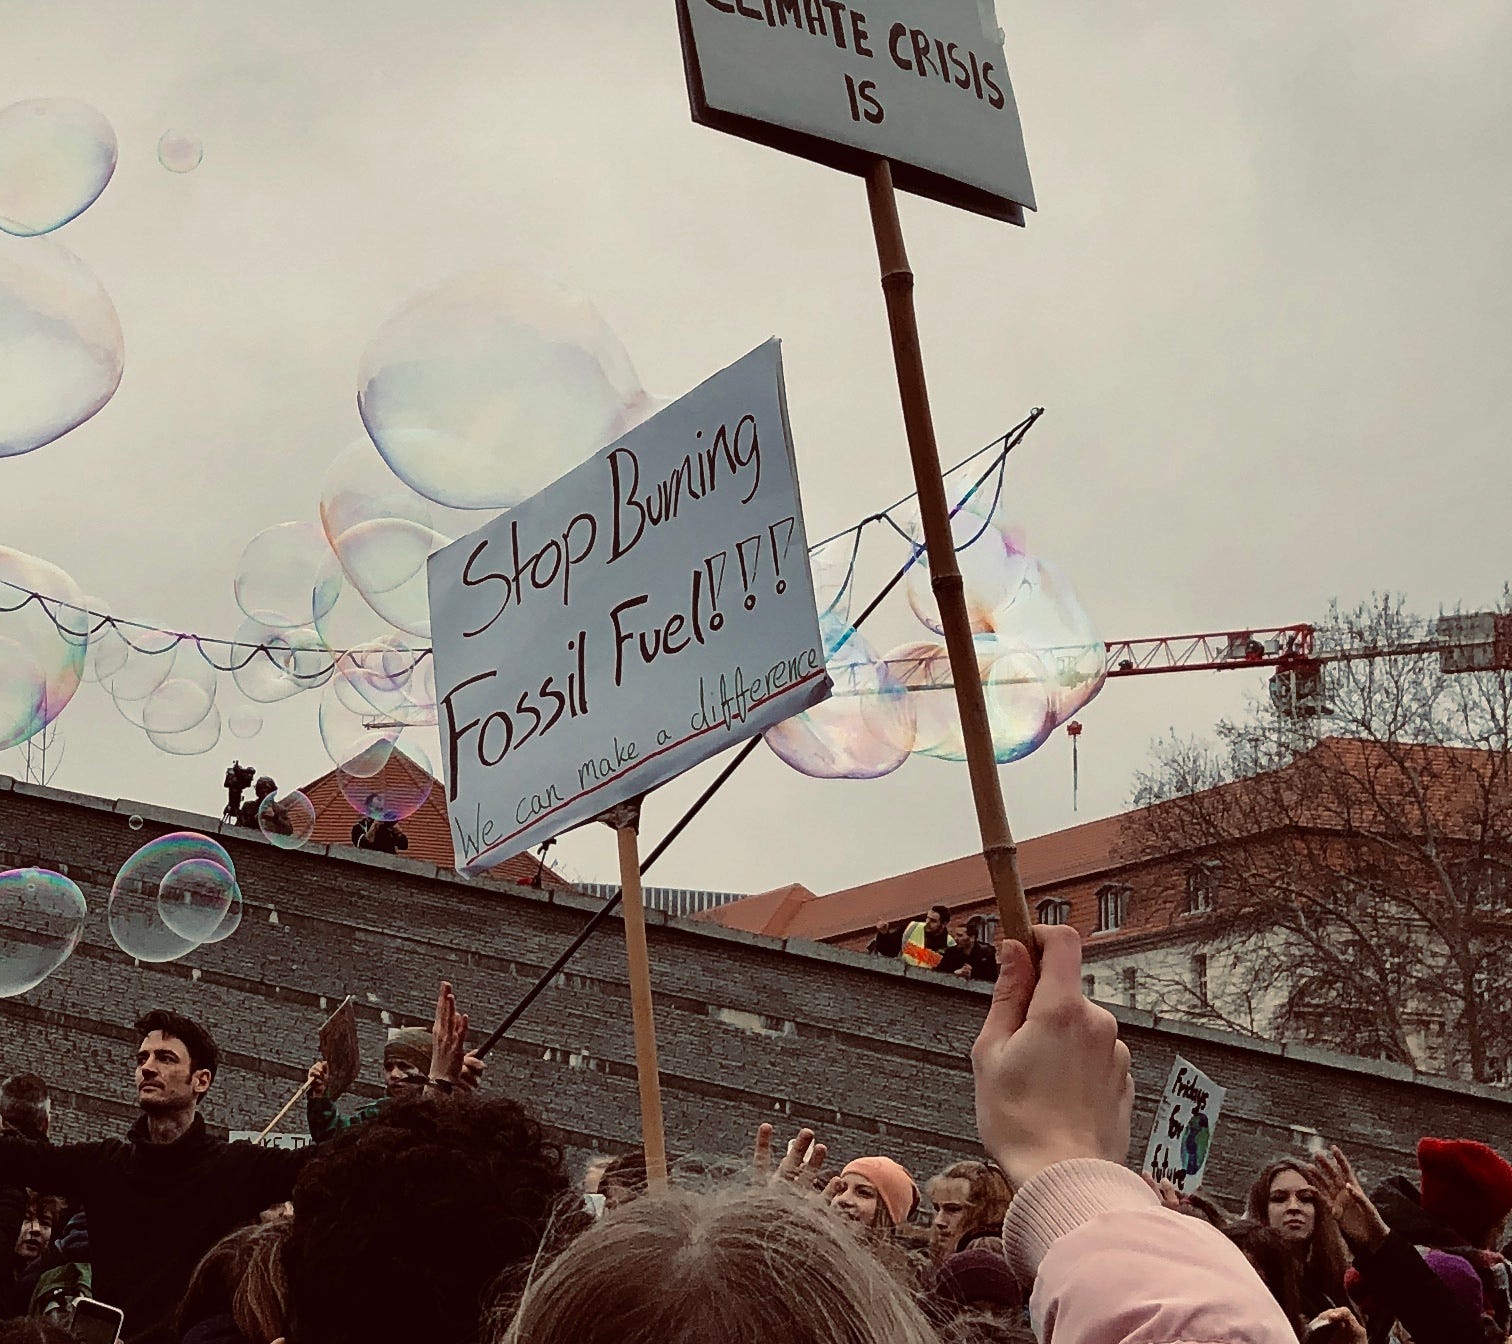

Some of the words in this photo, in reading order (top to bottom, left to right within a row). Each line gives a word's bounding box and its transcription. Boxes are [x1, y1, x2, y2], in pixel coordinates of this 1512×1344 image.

[844, 74, 884, 125] IS
[888, 22, 1006, 111] CRISIS
[461, 512, 597, 637] Stop
[606, 413, 761, 564] Burning
[440, 631, 588, 801] Fossil
[454, 803, 501, 859] We
[515, 783, 564, 824] can
[577, 737, 640, 788] make
[655, 728, 672, 747] a
[690, 647, 819, 733] difference
